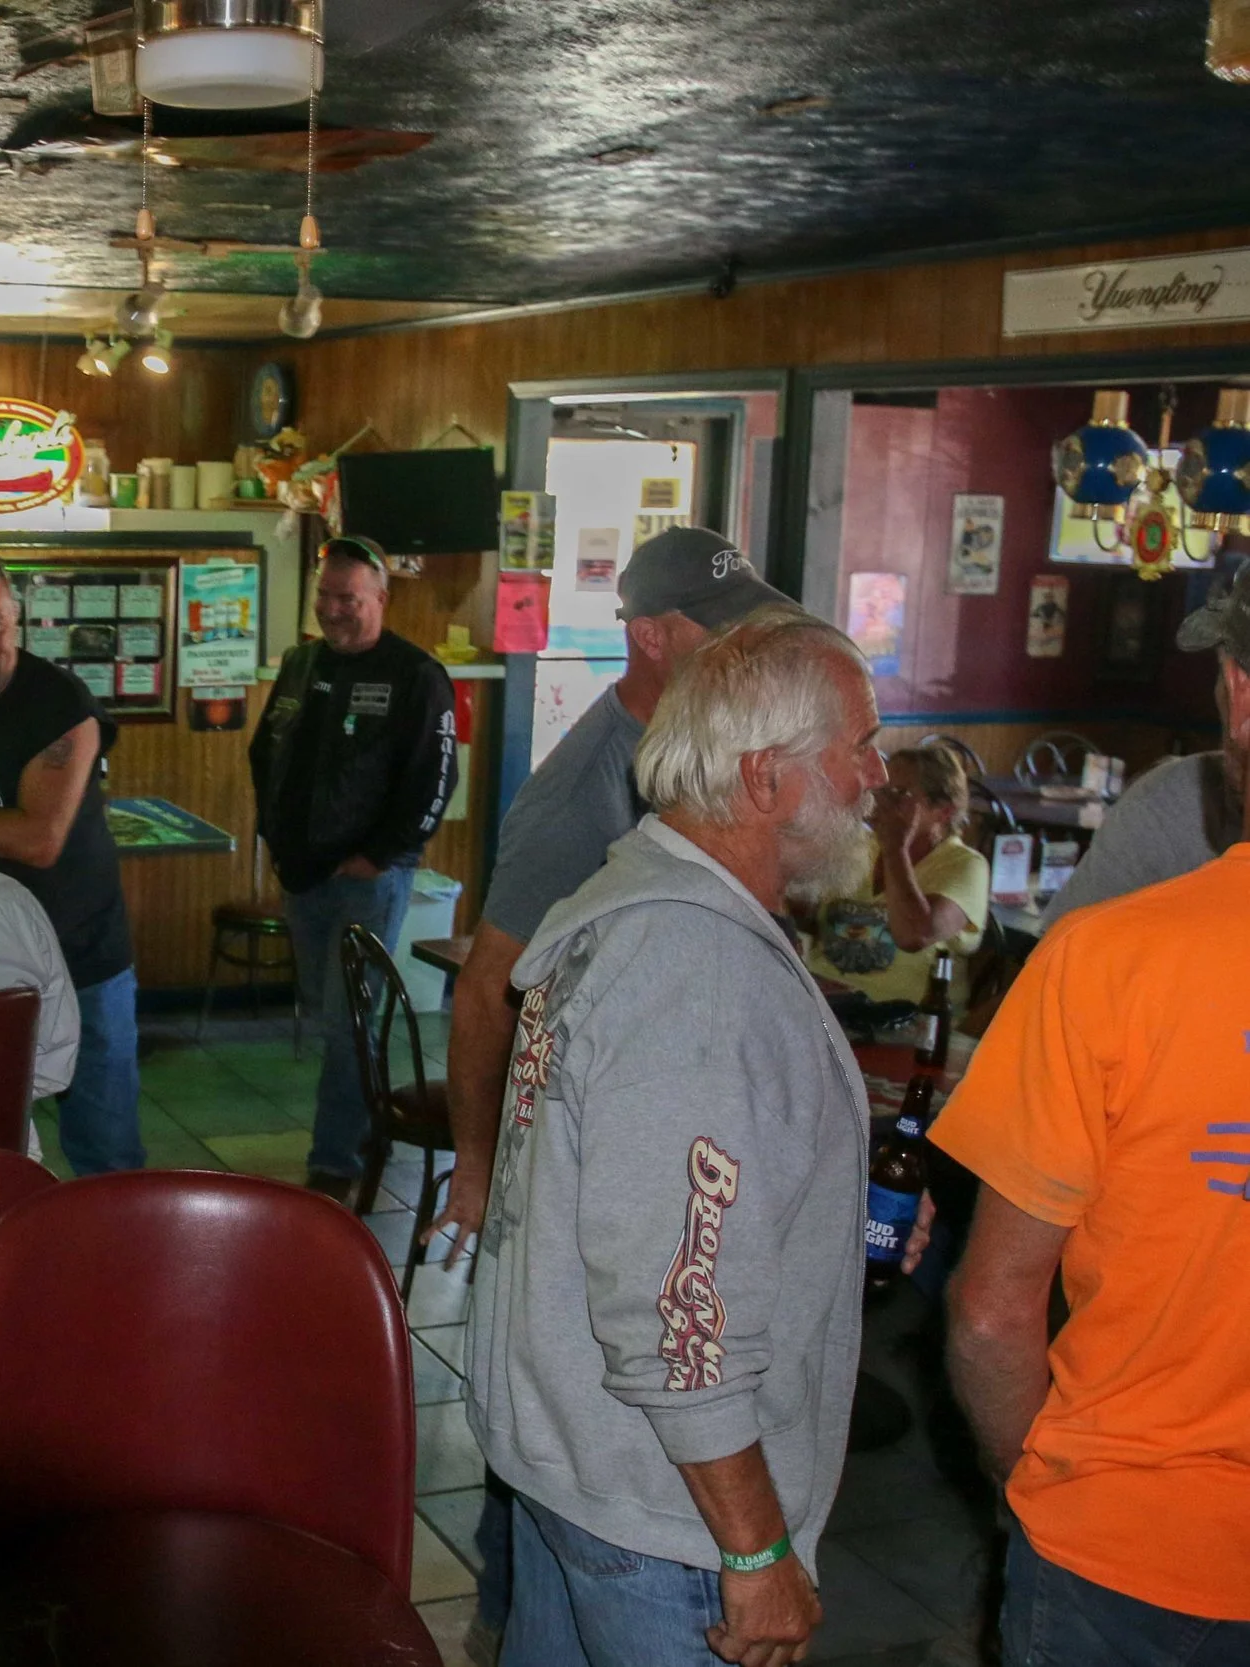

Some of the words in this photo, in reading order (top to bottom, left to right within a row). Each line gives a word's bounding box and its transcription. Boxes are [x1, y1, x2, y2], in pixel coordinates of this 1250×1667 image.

[1077, 263, 1225, 322] Yuengling
[676, 1136, 740, 1337] BROKEN
[865, 1233, 899, 1249] GHT
